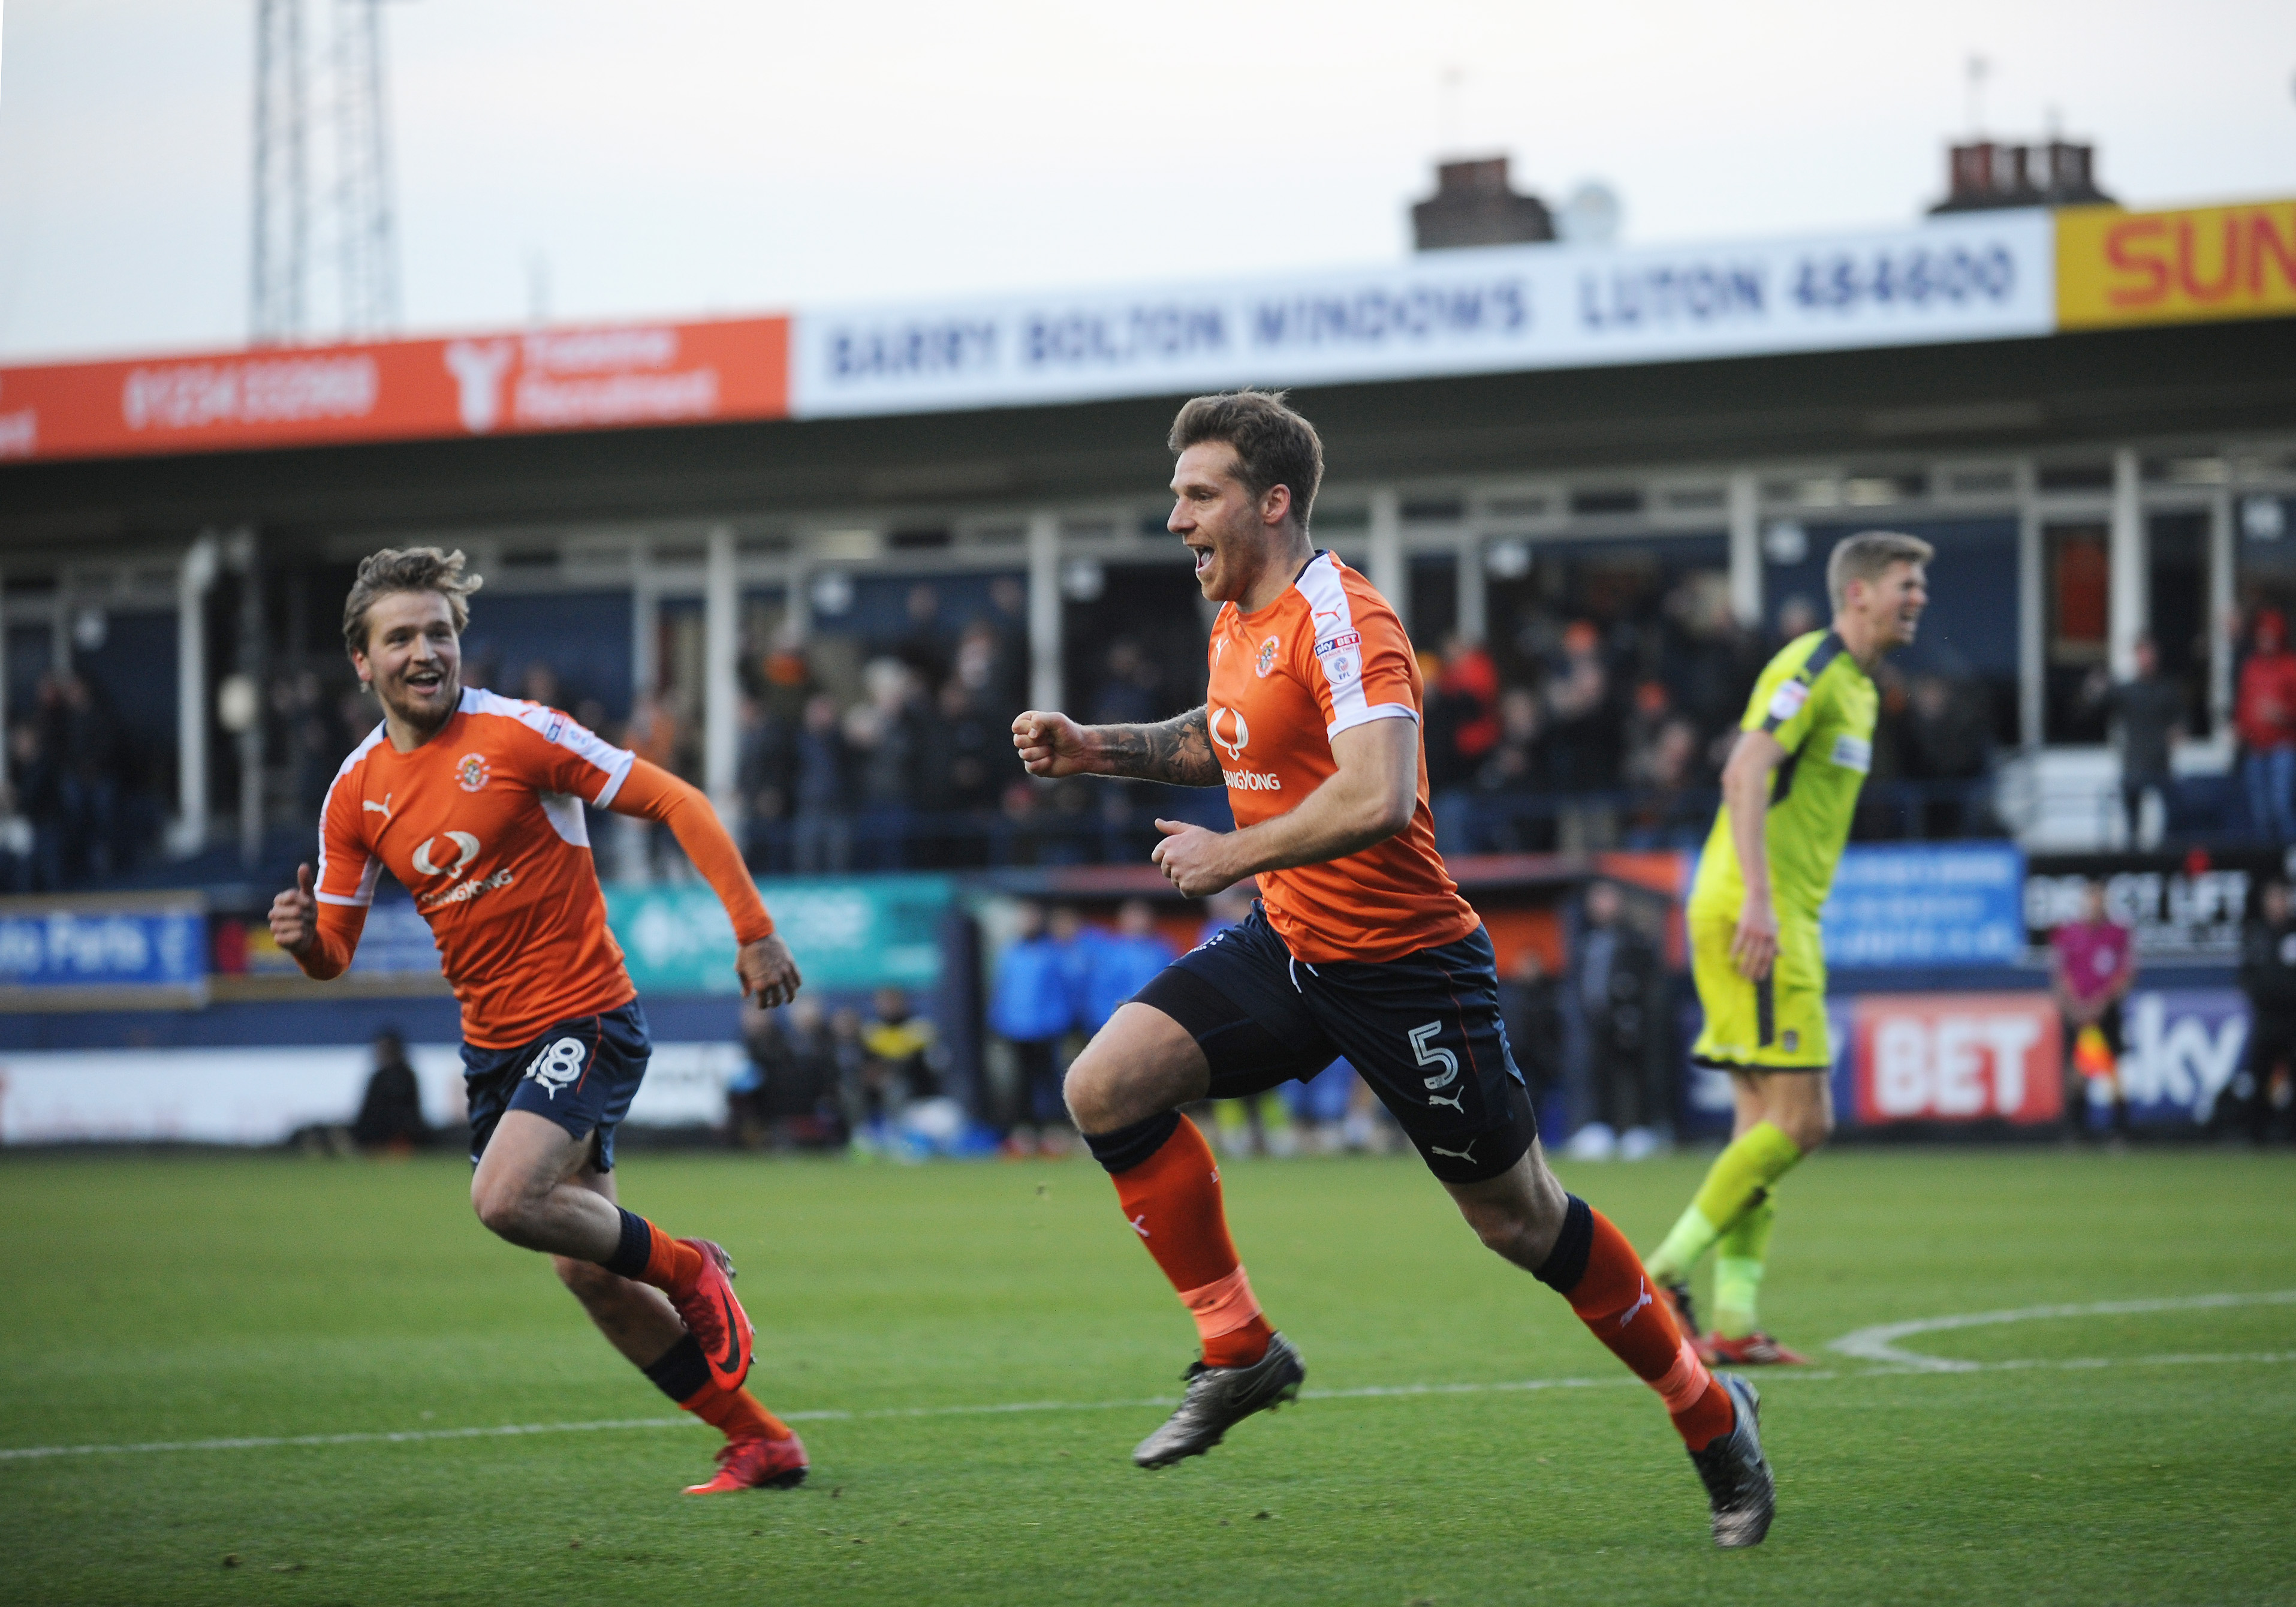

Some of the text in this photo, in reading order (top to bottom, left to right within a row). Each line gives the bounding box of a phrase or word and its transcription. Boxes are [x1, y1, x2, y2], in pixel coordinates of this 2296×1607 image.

[2103, 213, 2296, 305] SUN
[828, 320, 996, 384] BARRY
[1022, 304, 1226, 368] BOLTON
[1253, 281, 1527, 349] WINDOWS
[1578, 264, 1765, 332] LUTON
[1336, 633, 1357, 647] BET
[1339, 671, 1350, 681] EFL
[526, 1037, 586, 1082] 18
[1408, 1020, 1459, 1090] 5
[1872, 1015, 2039, 1119] BET
